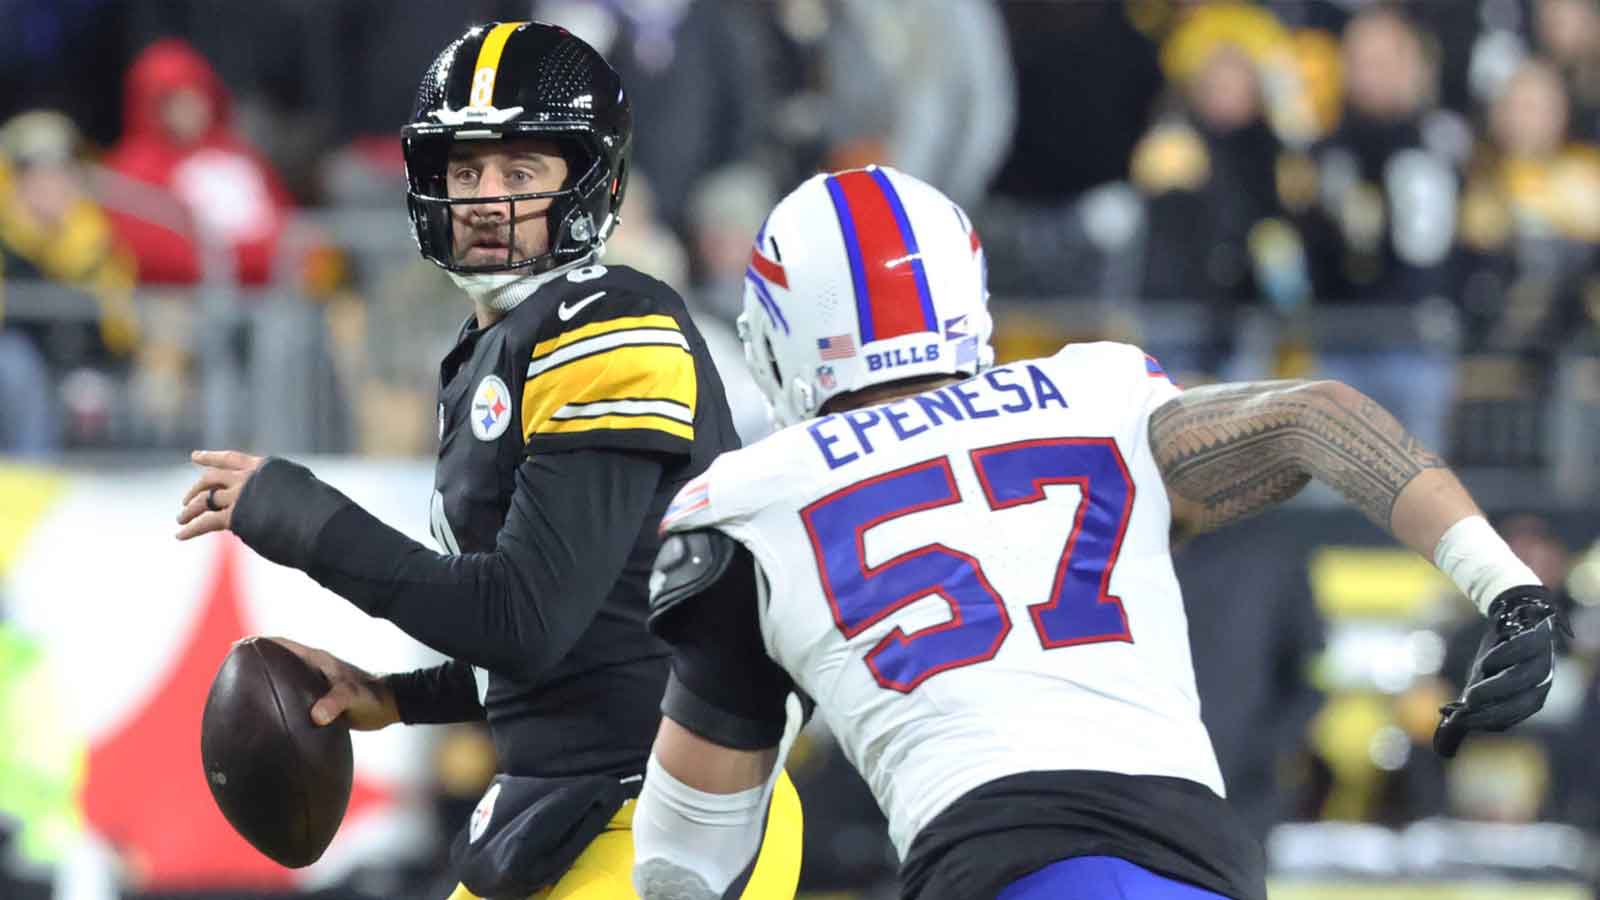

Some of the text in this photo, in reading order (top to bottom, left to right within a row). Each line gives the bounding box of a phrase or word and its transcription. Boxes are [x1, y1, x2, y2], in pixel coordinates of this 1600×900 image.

[470, 67, 496, 107] 8
[866, 343, 940, 372] BILLS
[806, 364, 1069, 470] EPENESA
[798, 437, 1136, 694] 57
